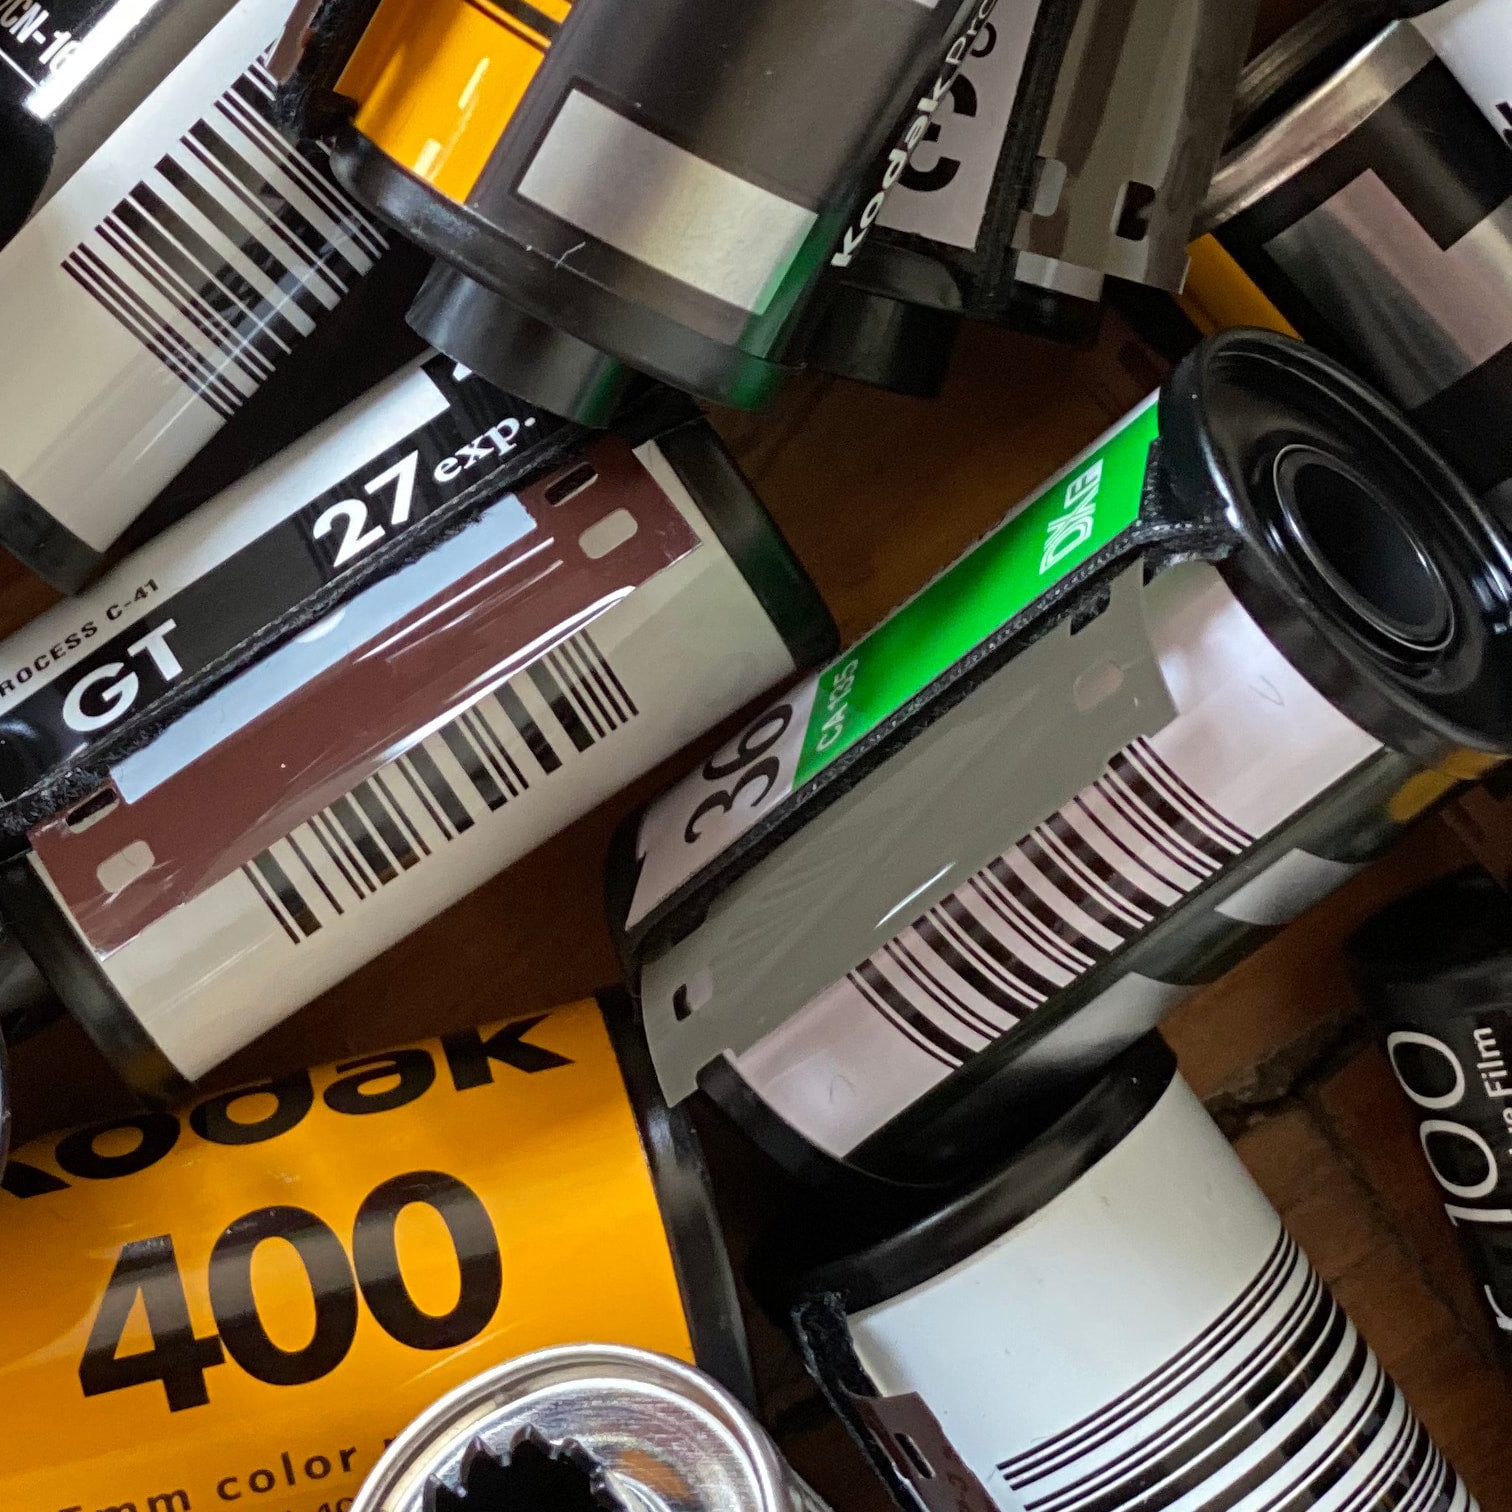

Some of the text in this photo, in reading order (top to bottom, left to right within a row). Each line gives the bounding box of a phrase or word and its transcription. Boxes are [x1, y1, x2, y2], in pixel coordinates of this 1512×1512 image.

[831, 73, 956, 267] Kodak
[62, 416, 535, 732] GT 27 exp.
[106, 578, 158, 622] C-41
[684, 703, 793, 843] 36
[78, 1170, 503, 1413] 400
[217, 1451, 358, 1501] color
